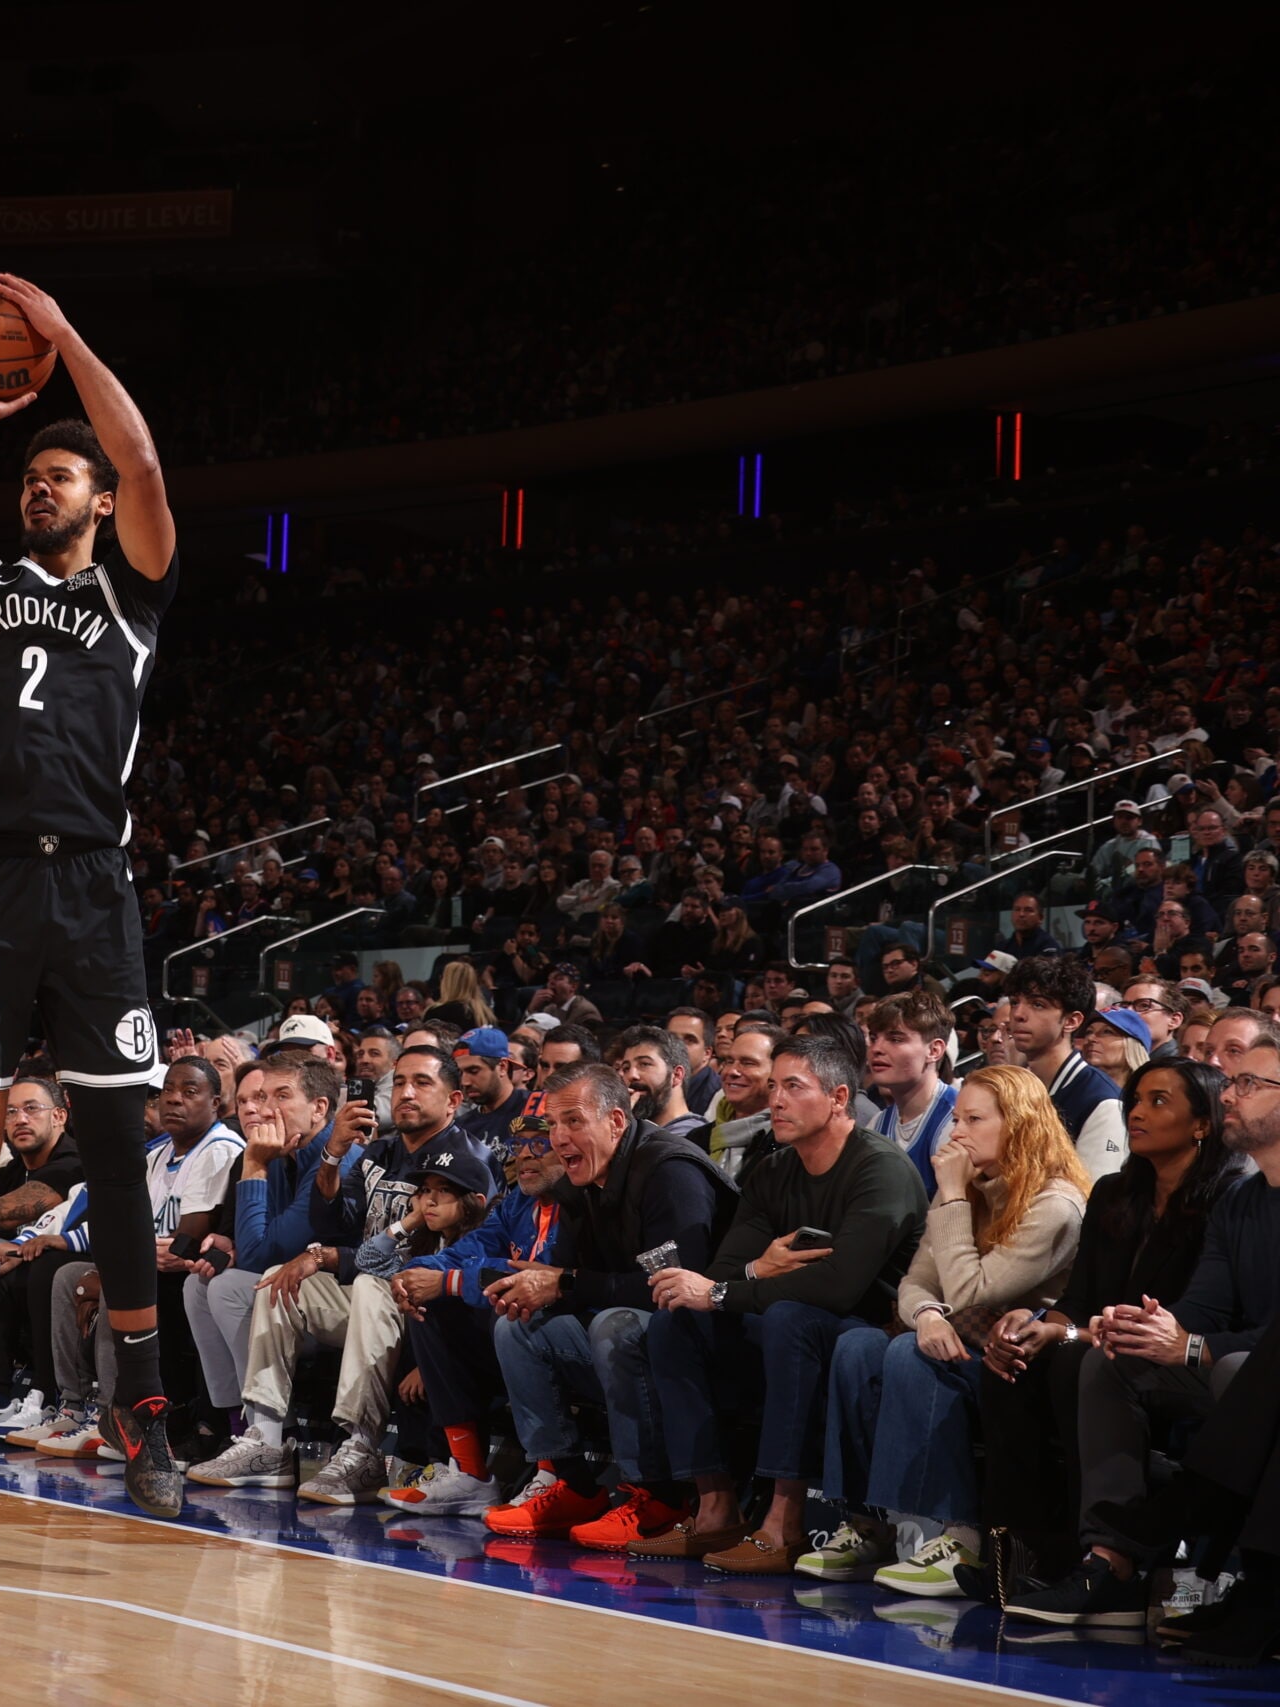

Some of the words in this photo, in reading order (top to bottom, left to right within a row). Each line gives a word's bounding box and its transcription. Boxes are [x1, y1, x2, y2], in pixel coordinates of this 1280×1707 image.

[65, 207, 137, 231] SUITE
[146, 204, 223, 229] LEVEL
[18, 645, 48, 711] 2
[1004, 822, 1018, 834] 117
[40, 835, 58, 844] NETS
[952, 930, 963, 944] 13
[831, 938, 841, 951] 12
[133, 1015, 146, 1055] B
